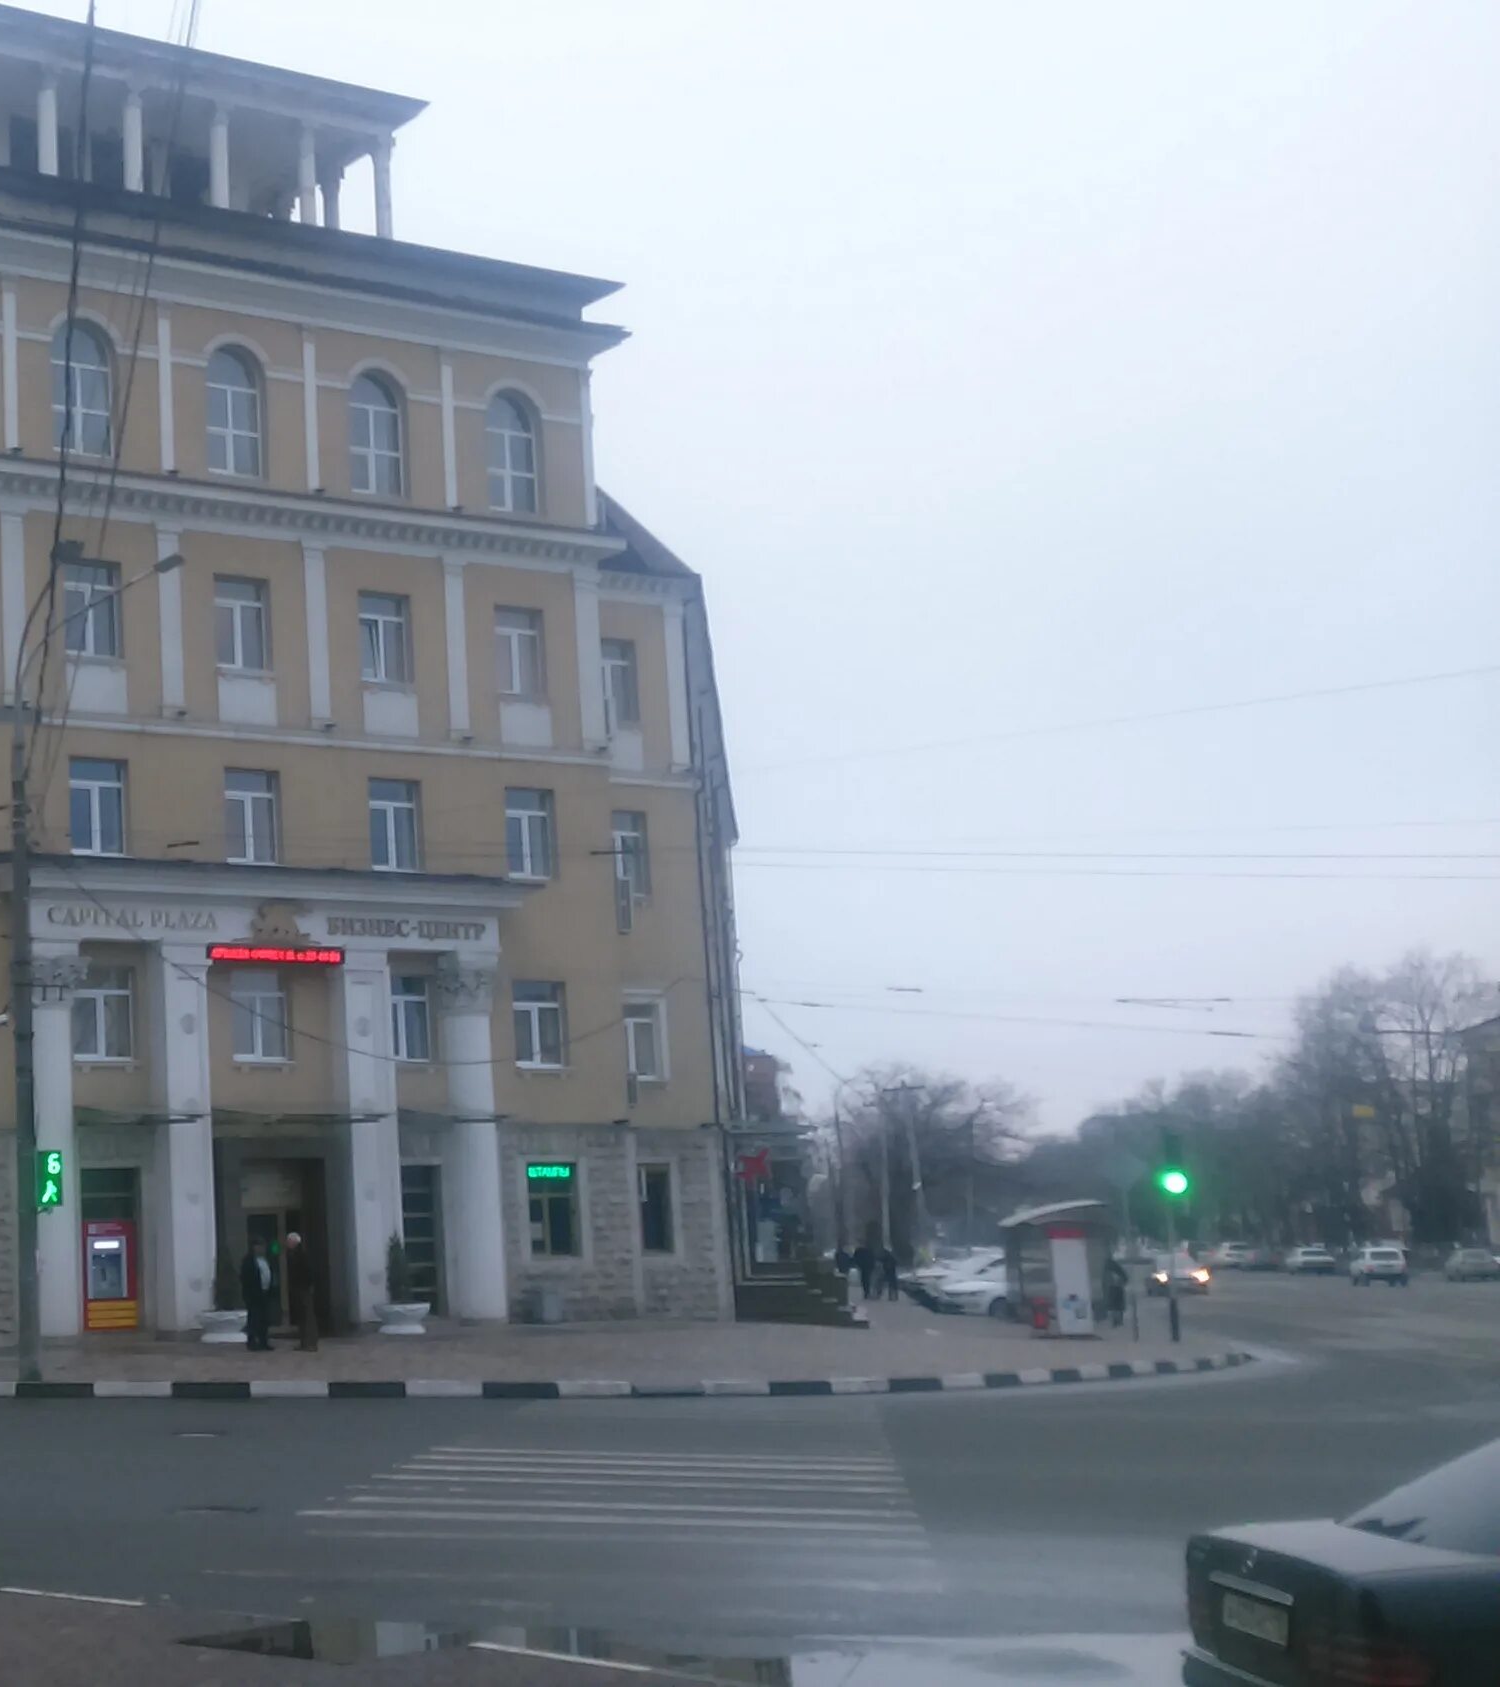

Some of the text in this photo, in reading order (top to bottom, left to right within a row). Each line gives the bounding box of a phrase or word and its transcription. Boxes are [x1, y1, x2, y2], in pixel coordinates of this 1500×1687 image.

[47, 904, 218, 929] CAPITAL PLAZA
[326, 917, 486, 941] БИЗНЕС-ЦЕНТР
[47, 1153, 61, 1174] 6
